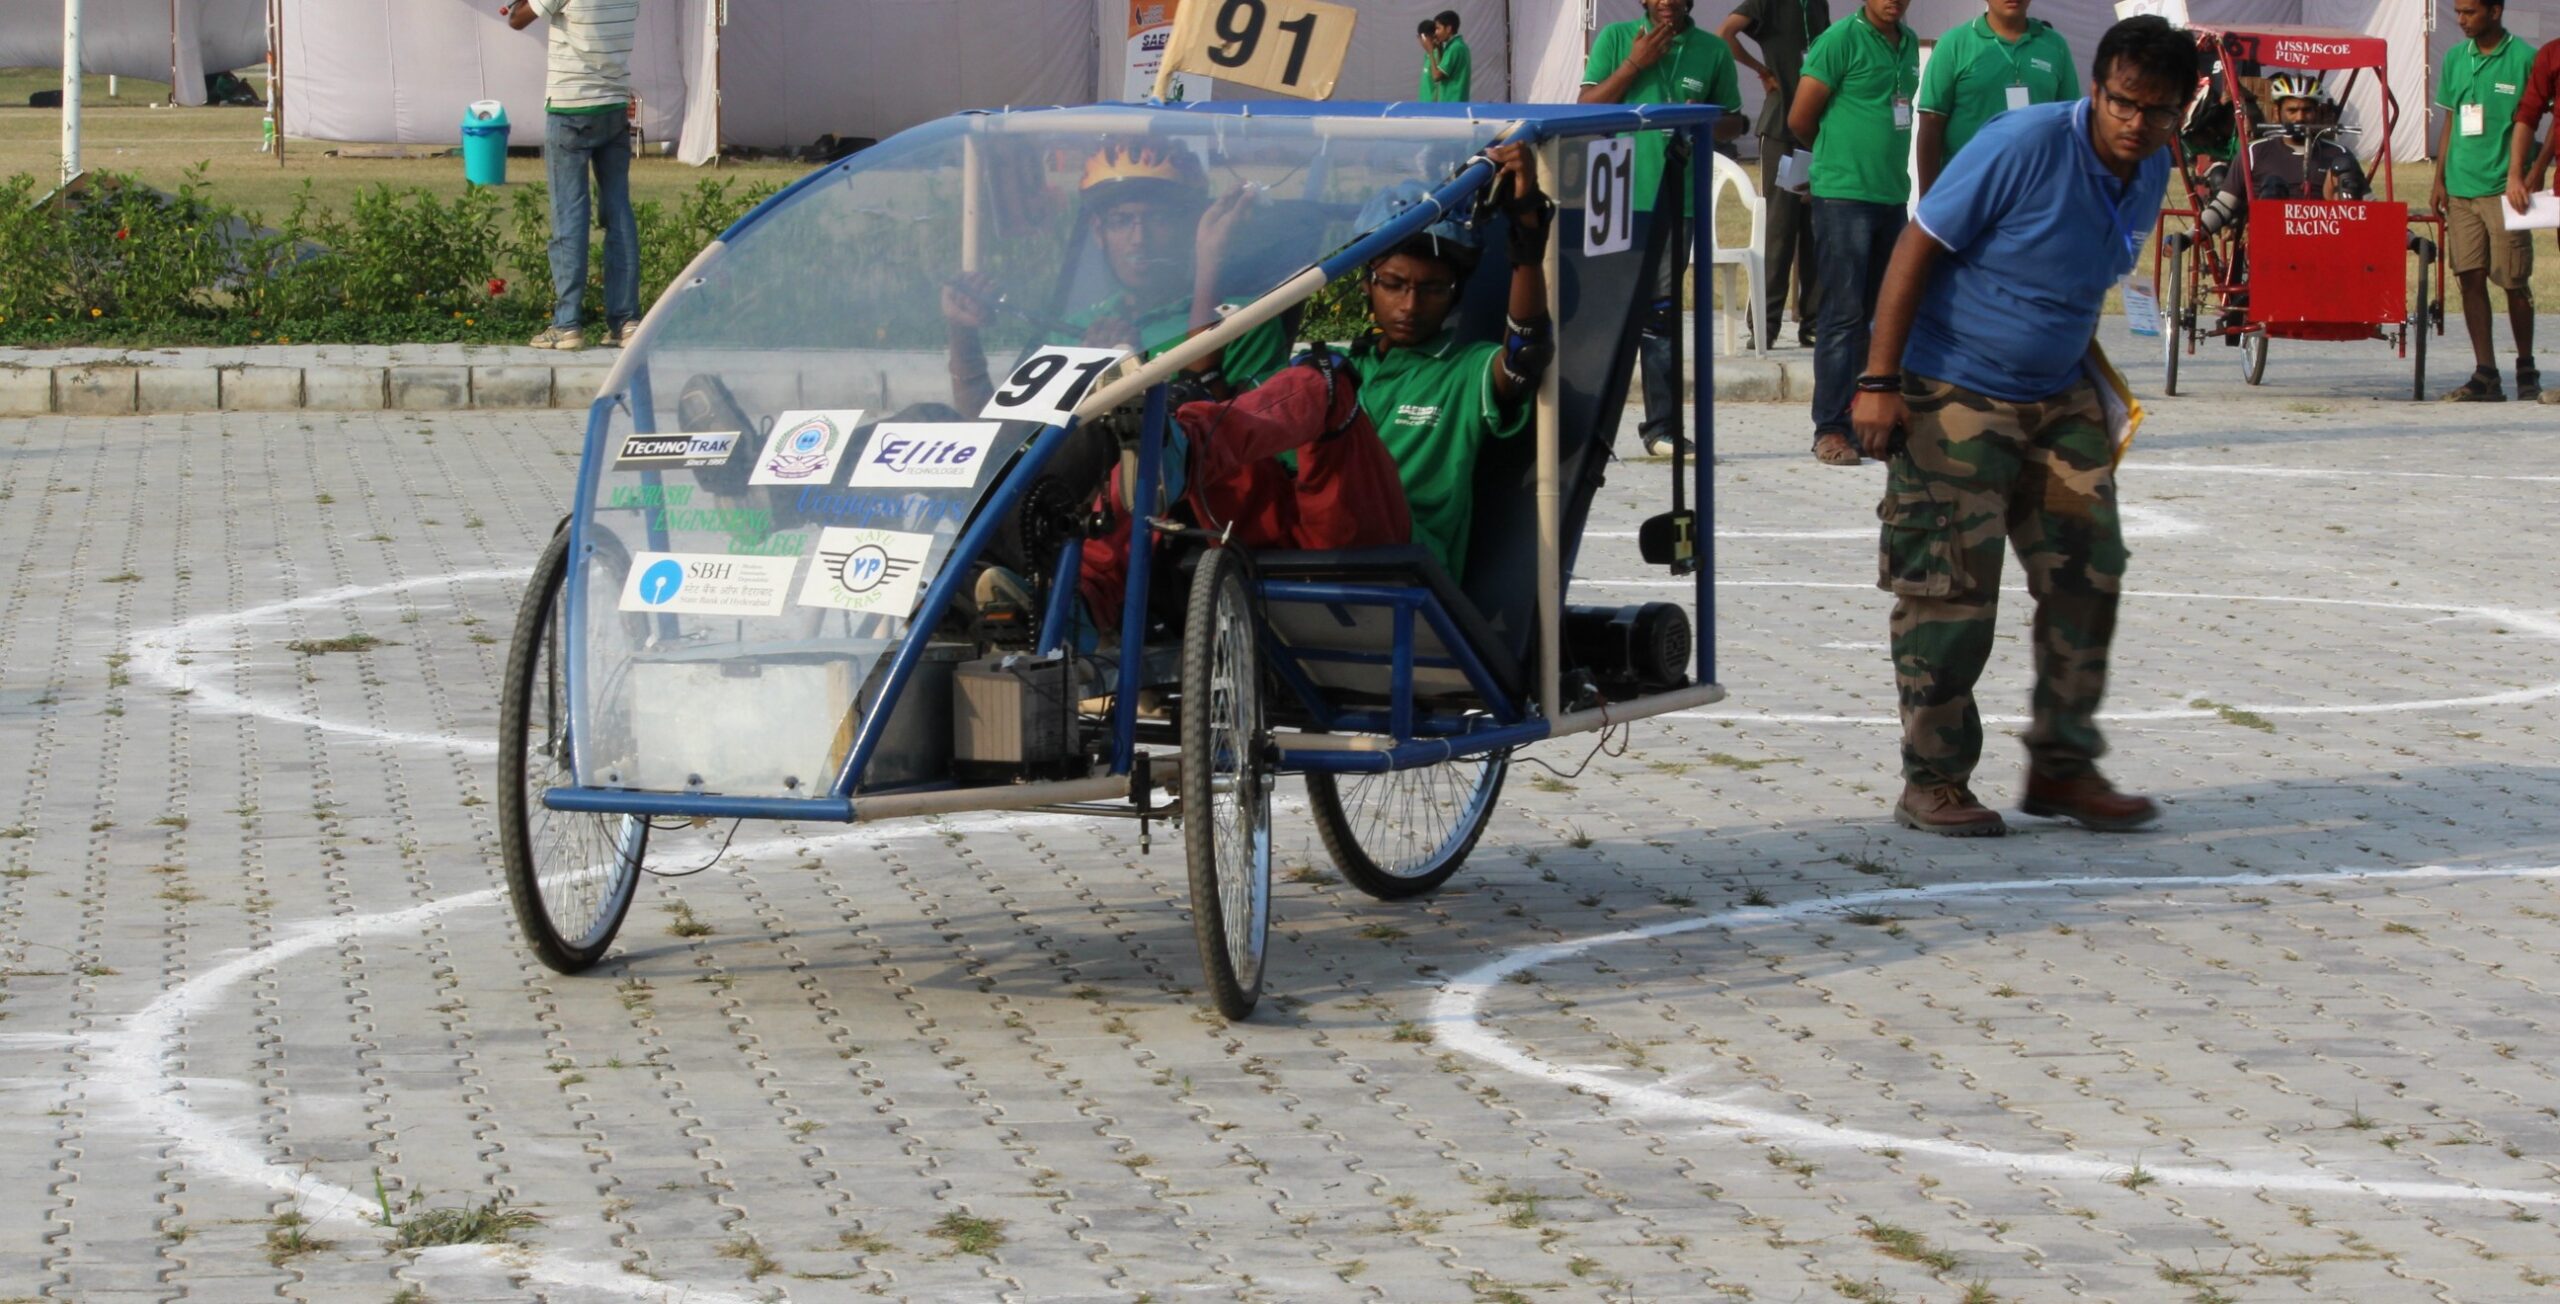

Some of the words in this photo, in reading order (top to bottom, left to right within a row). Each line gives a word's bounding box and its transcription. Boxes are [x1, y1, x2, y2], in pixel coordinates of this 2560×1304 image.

[1207, 0, 1318, 86] 91
[2275, 40, 2350, 54] AISSMSCOE
[2275, 50, 2309, 65] PUNE
[1590, 148, 1631, 246] 91
[2284, 203, 2367, 220] RESONANCE
[2285, 219, 2340, 235] RACING
[995, 354, 1117, 412] 91
[625, 440, 730, 454] TECHNOTRAK
[873, 439, 977, 464] Elite
[905, 466, 966, 475] TECHNOLOGIES
[653, 509, 773, 532] ENGINEERING
[728, 533, 809, 557] COLLEGE
[855, 530, 897, 545] VAYU
[687, 561, 732, 580] SBH
[829, 584, 882, 609] PUTRAS
